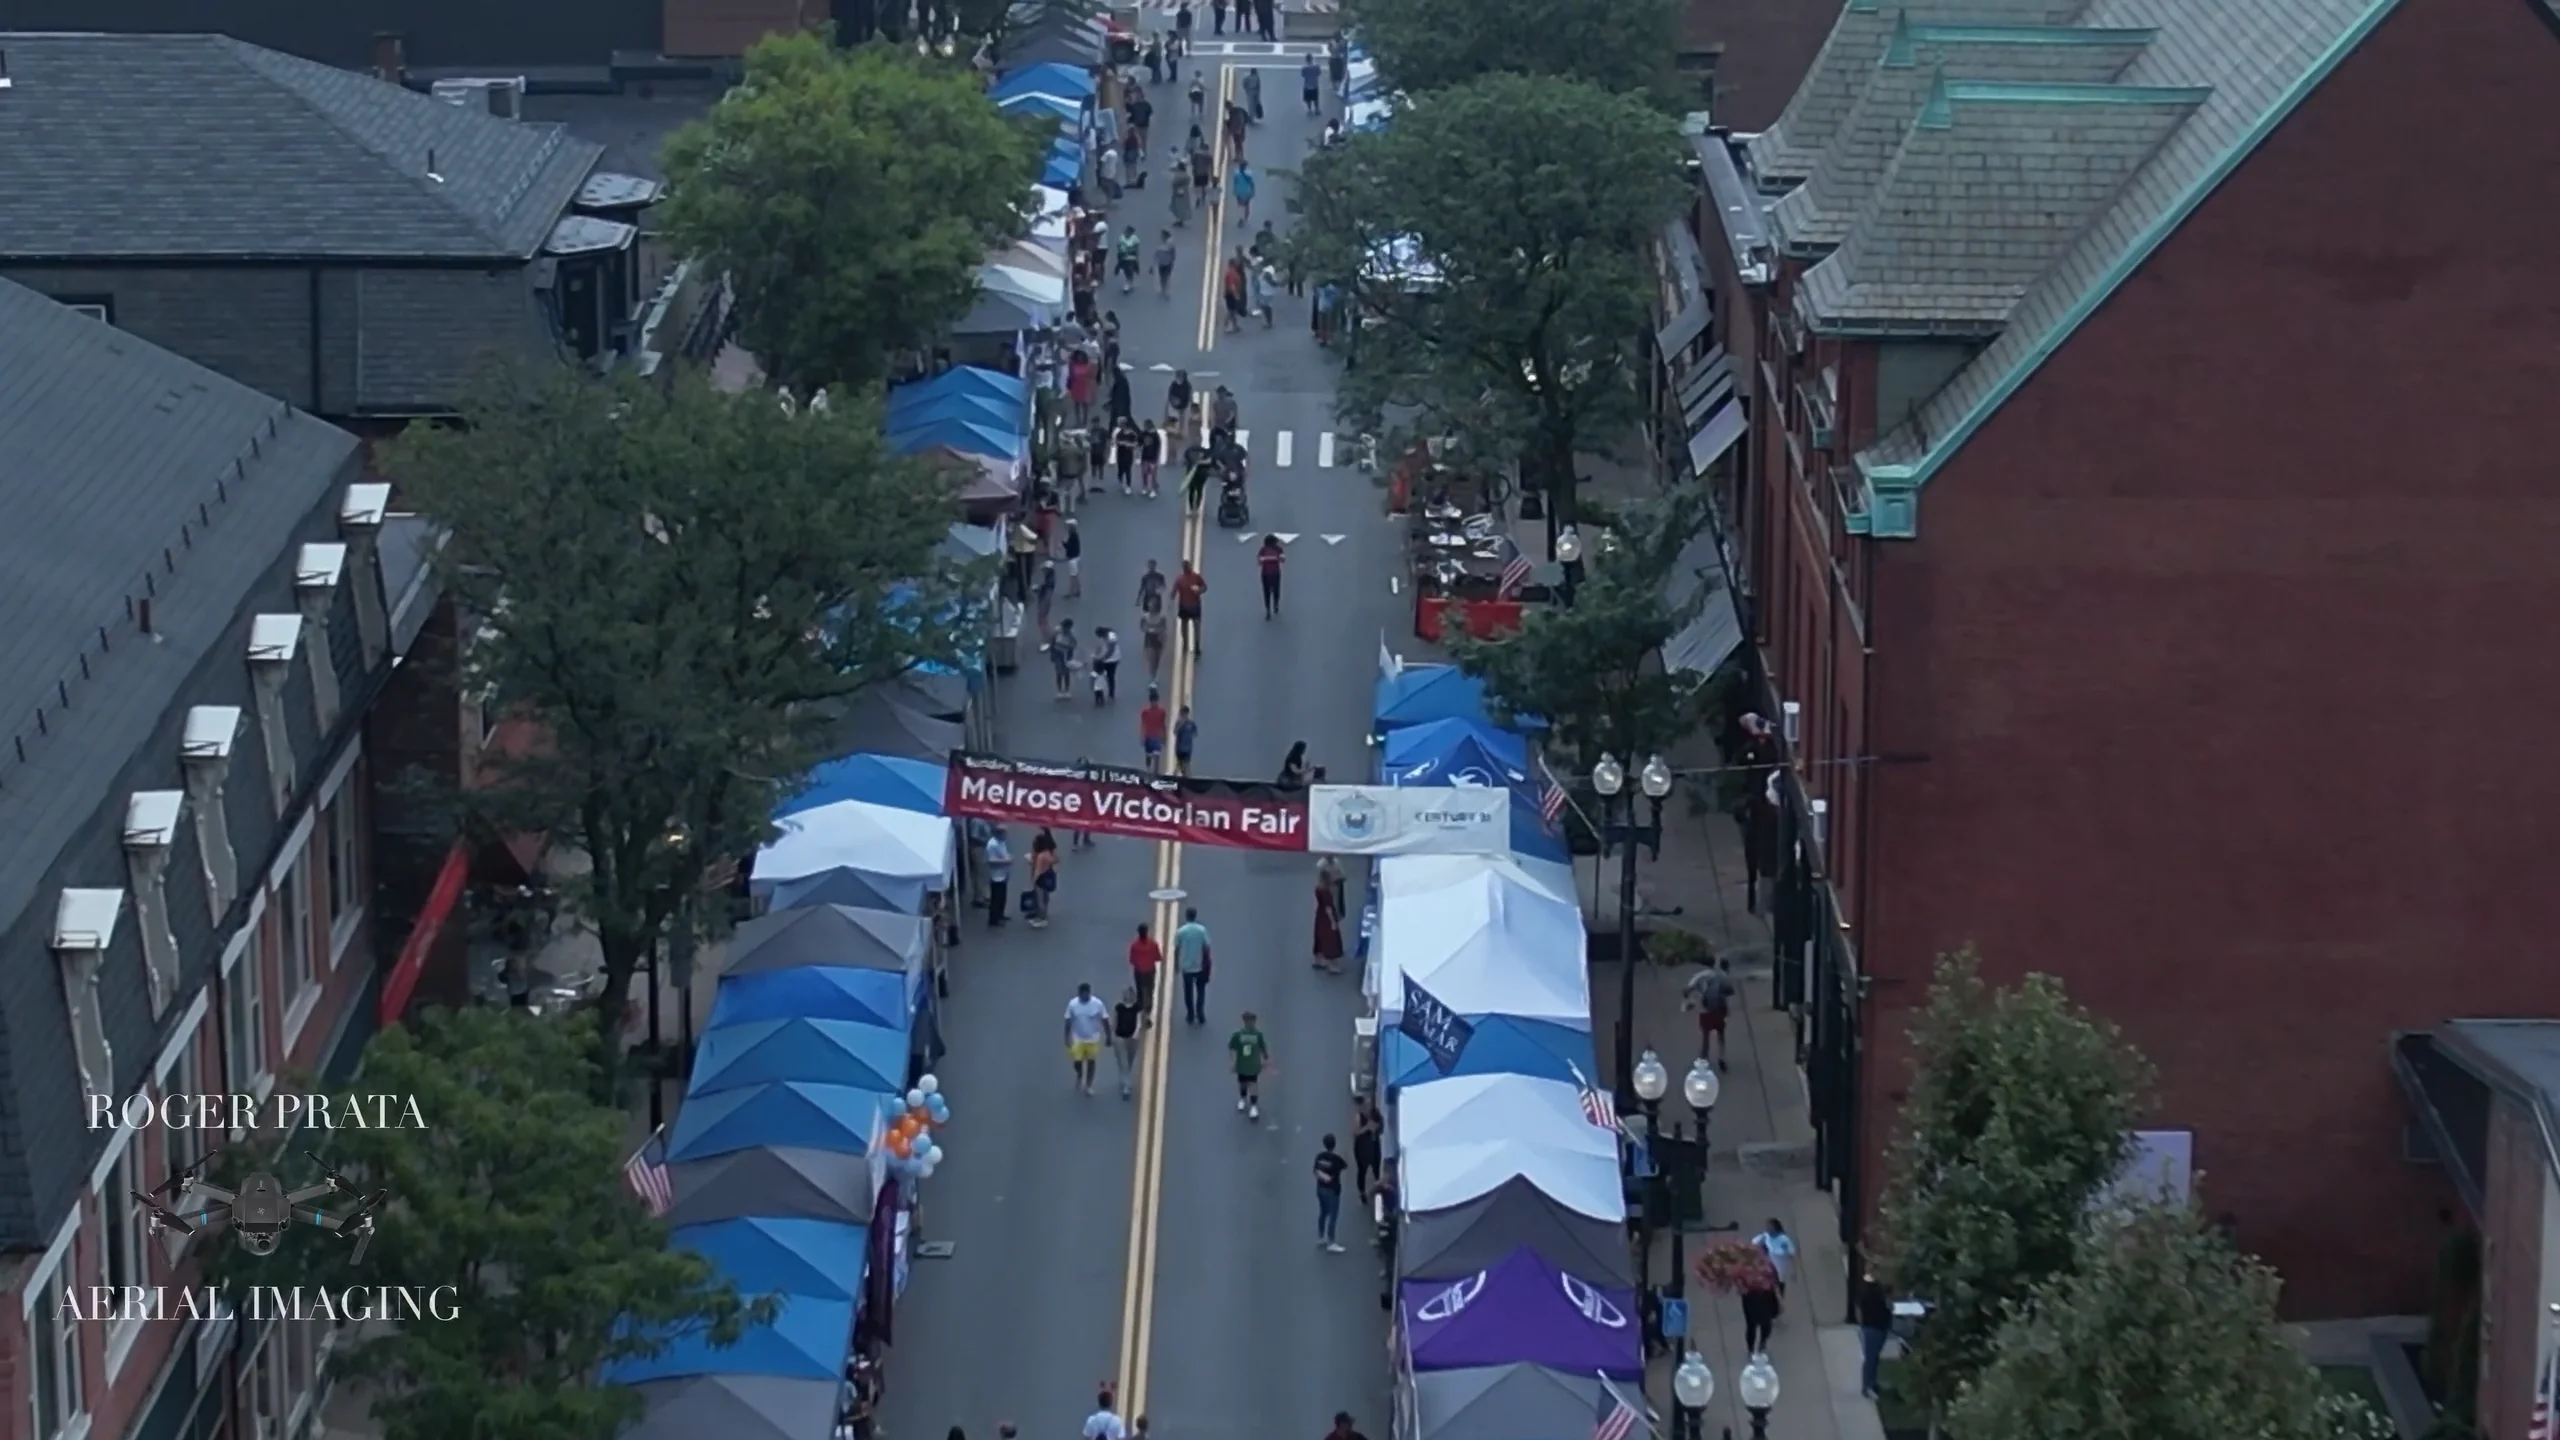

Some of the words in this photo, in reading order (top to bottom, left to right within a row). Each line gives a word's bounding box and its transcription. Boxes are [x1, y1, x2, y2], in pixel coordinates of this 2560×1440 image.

[961, 776, 1081, 812] Melrose
[1093, 790, 1231, 830] Victorian
[1241, 807, 1301, 835] Fair
[1408, 989, 1453, 1030] SAM
